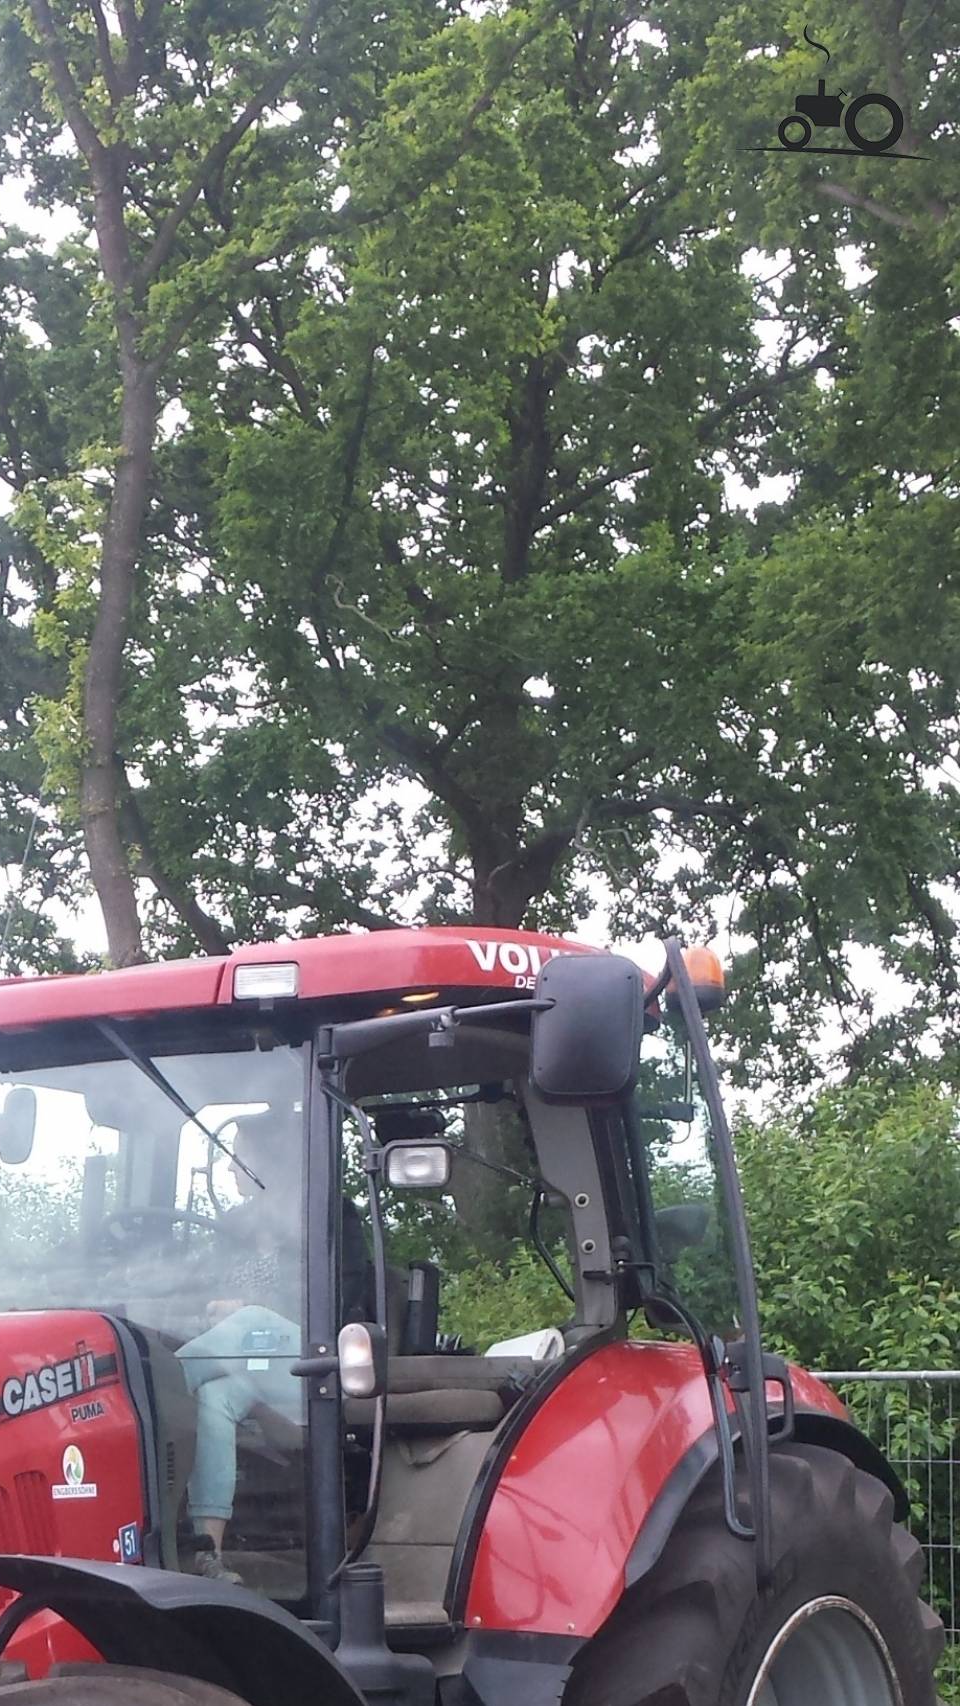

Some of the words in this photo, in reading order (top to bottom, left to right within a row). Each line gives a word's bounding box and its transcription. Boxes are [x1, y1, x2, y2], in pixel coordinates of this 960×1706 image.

[514, 975, 537, 990] DE
[2, 1360, 74, 1416] CASE
[71, 1402, 104, 1422] PUMA
[124, 1530, 136, 1556] 51
